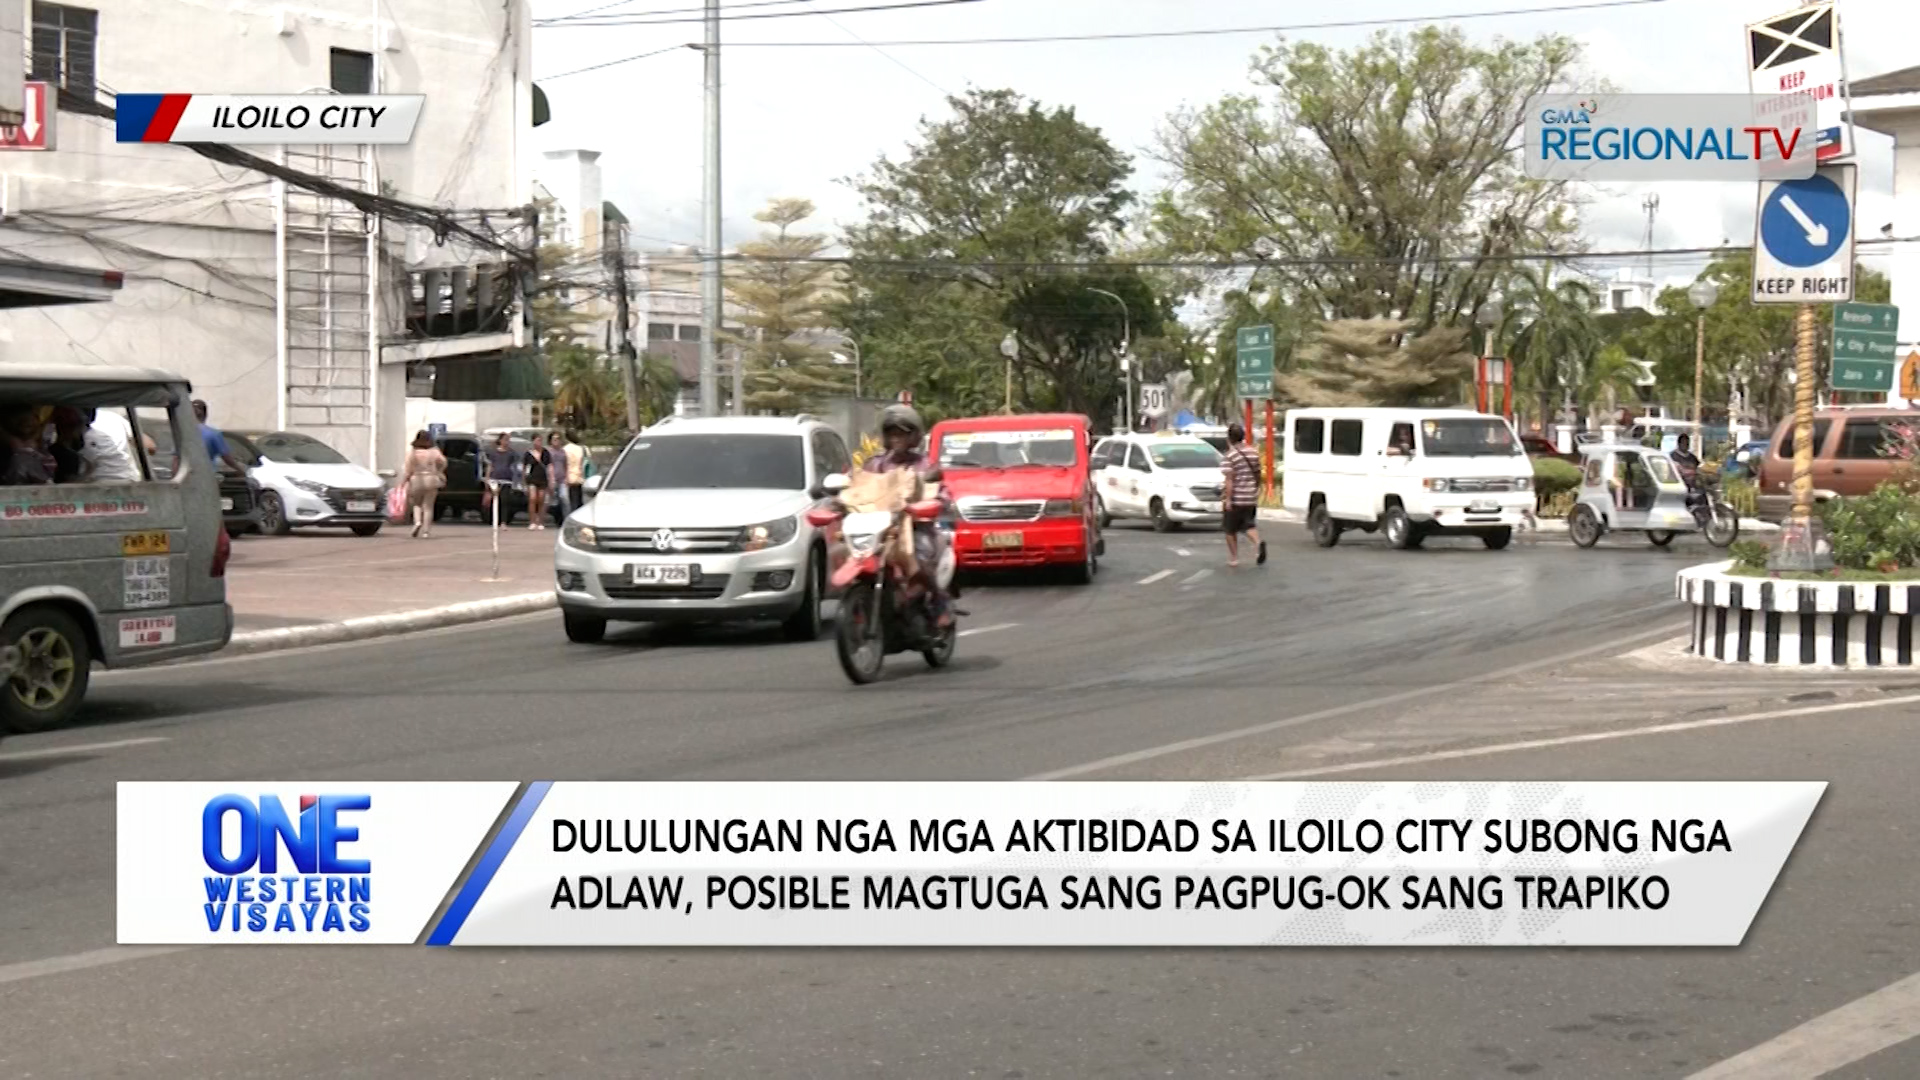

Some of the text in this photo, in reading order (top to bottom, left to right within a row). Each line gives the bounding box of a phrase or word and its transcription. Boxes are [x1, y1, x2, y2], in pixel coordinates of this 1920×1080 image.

[1779, 70, 1806, 92] KEEP
[1780, 109, 1808, 130] OPEN
[1756, 276, 1849, 294] KEEP RIGHT
